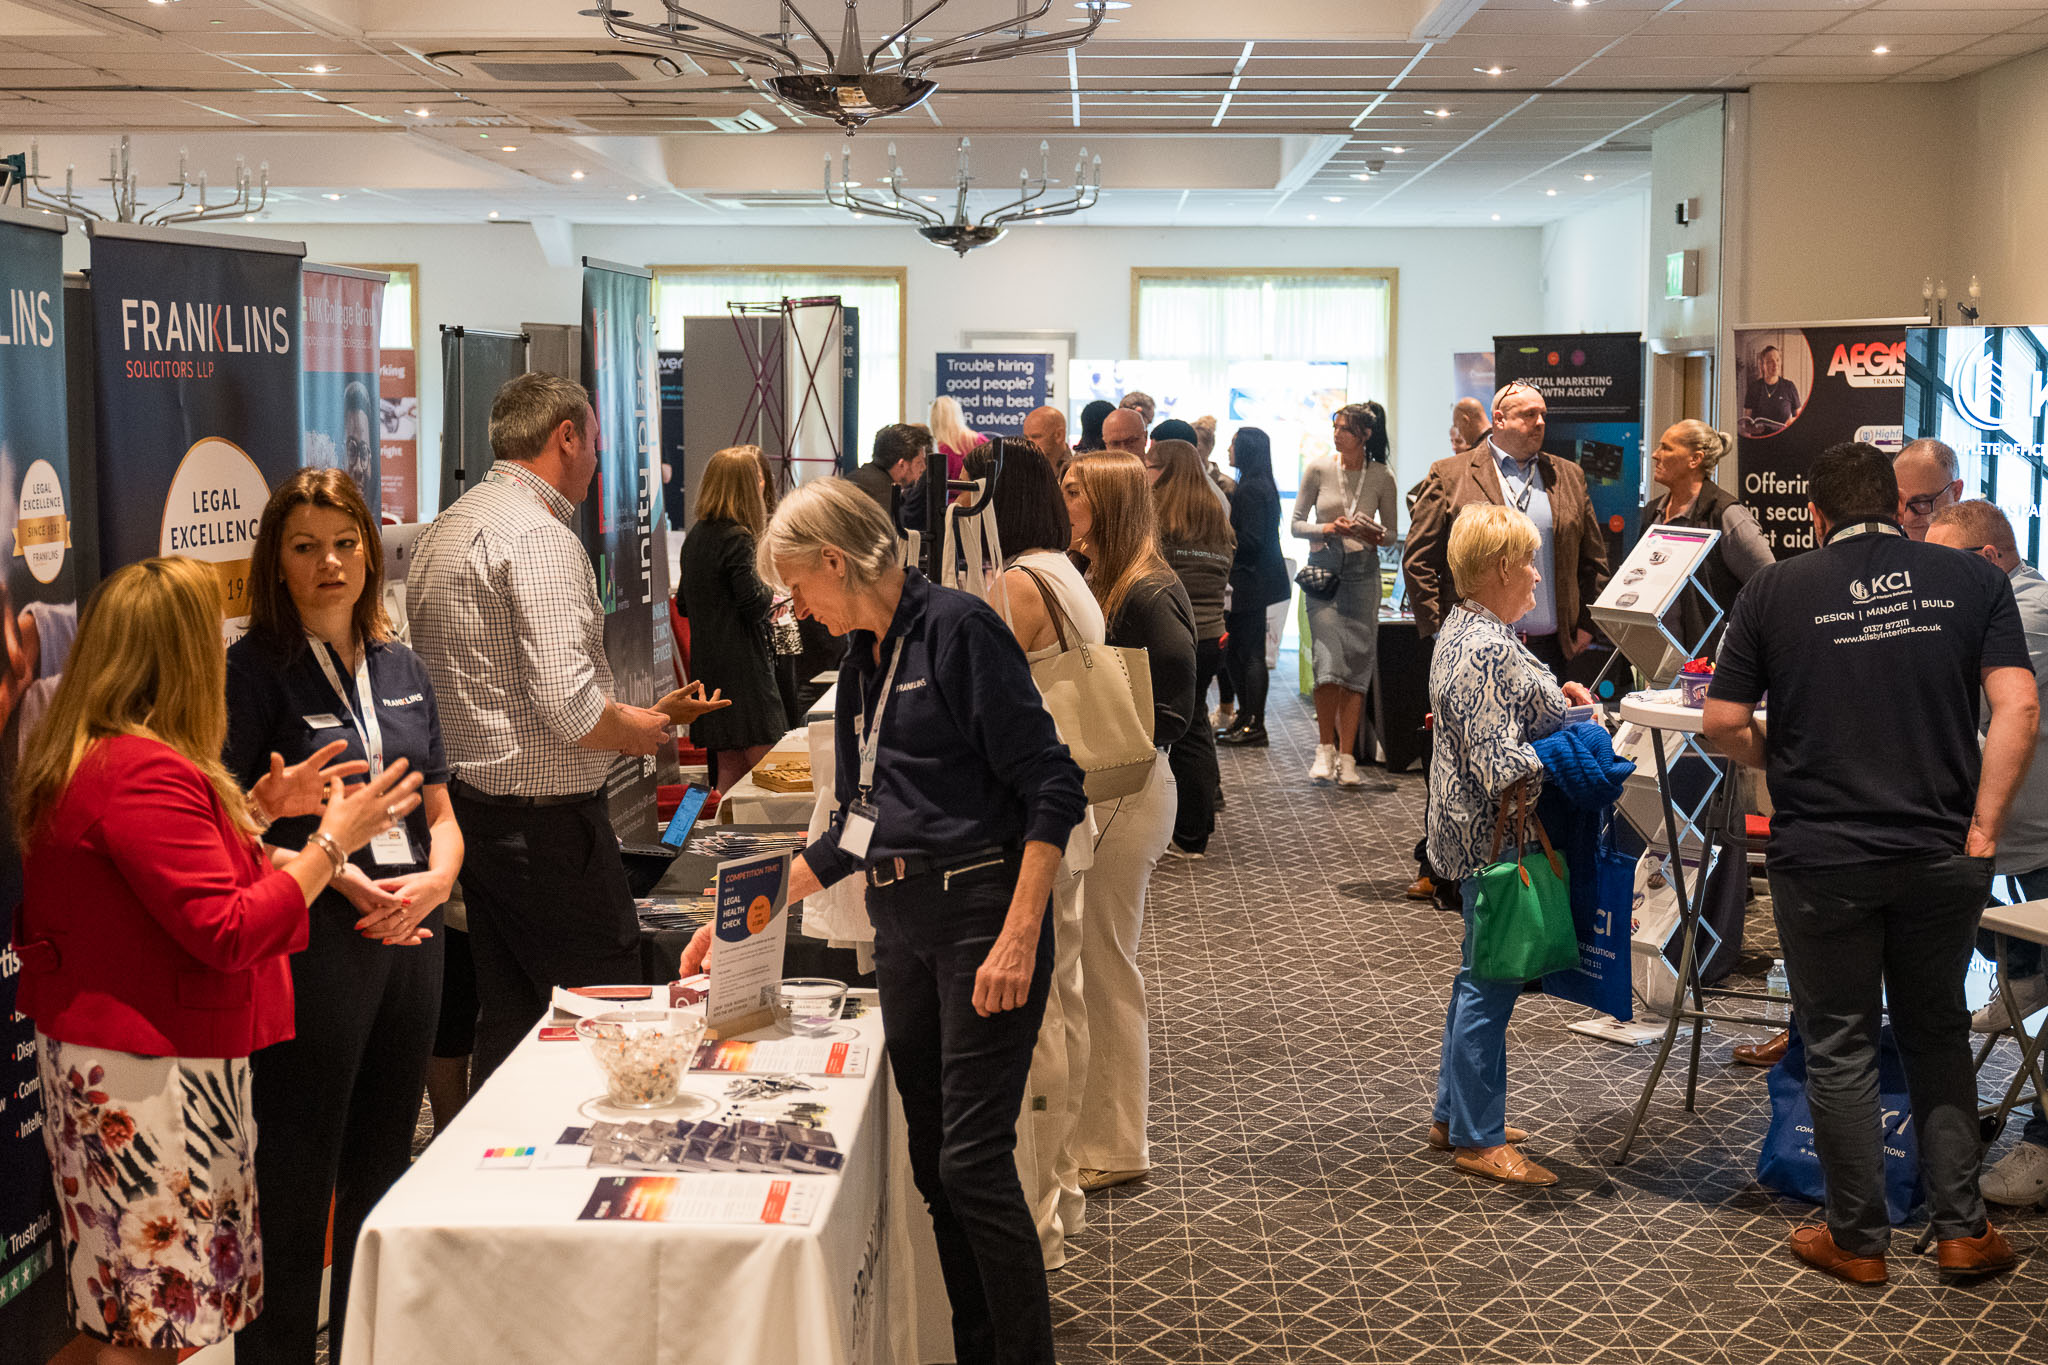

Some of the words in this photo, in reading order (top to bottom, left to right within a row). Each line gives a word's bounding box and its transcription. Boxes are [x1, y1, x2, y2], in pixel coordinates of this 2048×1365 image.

[121, 298, 290, 355] FRANKLINS
[126, 360, 194, 379] SOLICITORS
[197, 361, 214, 378] LLP
[946, 358, 995, 372] Trouble
[997, 358, 1035, 375] hiring
[945, 376, 980, 392] good
[982, 376, 1035, 392] people?
[1556, 376, 1613, 386] MARKETING
[1540, 387, 1565, 397] OWTH
[1567, 387, 1606, 397] AGENCY
[955, 394, 980, 408] eed
[982, 394, 1004, 408] the
[1006, 394, 1035, 408] best
[976, 412, 1026, 426] advice?
[1875, 429, 1904, 439] Highfi
[33, 483, 52, 495] LEGAL
[23, 497, 61, 511] EXCELLENCE
[193, 488, 241, 514] LEGAL
[27, 525, 46, 538] SINCE
[171, 518, 259, 550] EXCELLENC
[637, 470, 651, 604] unity
[1783, 526, 1814, 549] aid
[1872, 570, 1912, 594] KCI
[1814, 610, 1855, 625] DESIGN
[1866, 602, 1909, 618] MANAGE
[1921, 599, 1955, 609] BUILD
[725, 869, 764, 884] COMPETITION
[723, 895, 741, 906] LEGAL
[722, 906, 746, 918] HEALTH
[721, 918, 741, 930] CHECK
[1586, 944, 1616, 960] SOLUTIONS
[1883, 1145, 1906, 1159] TIONS
[9, 1209, 52, 1256] Trustpilot
